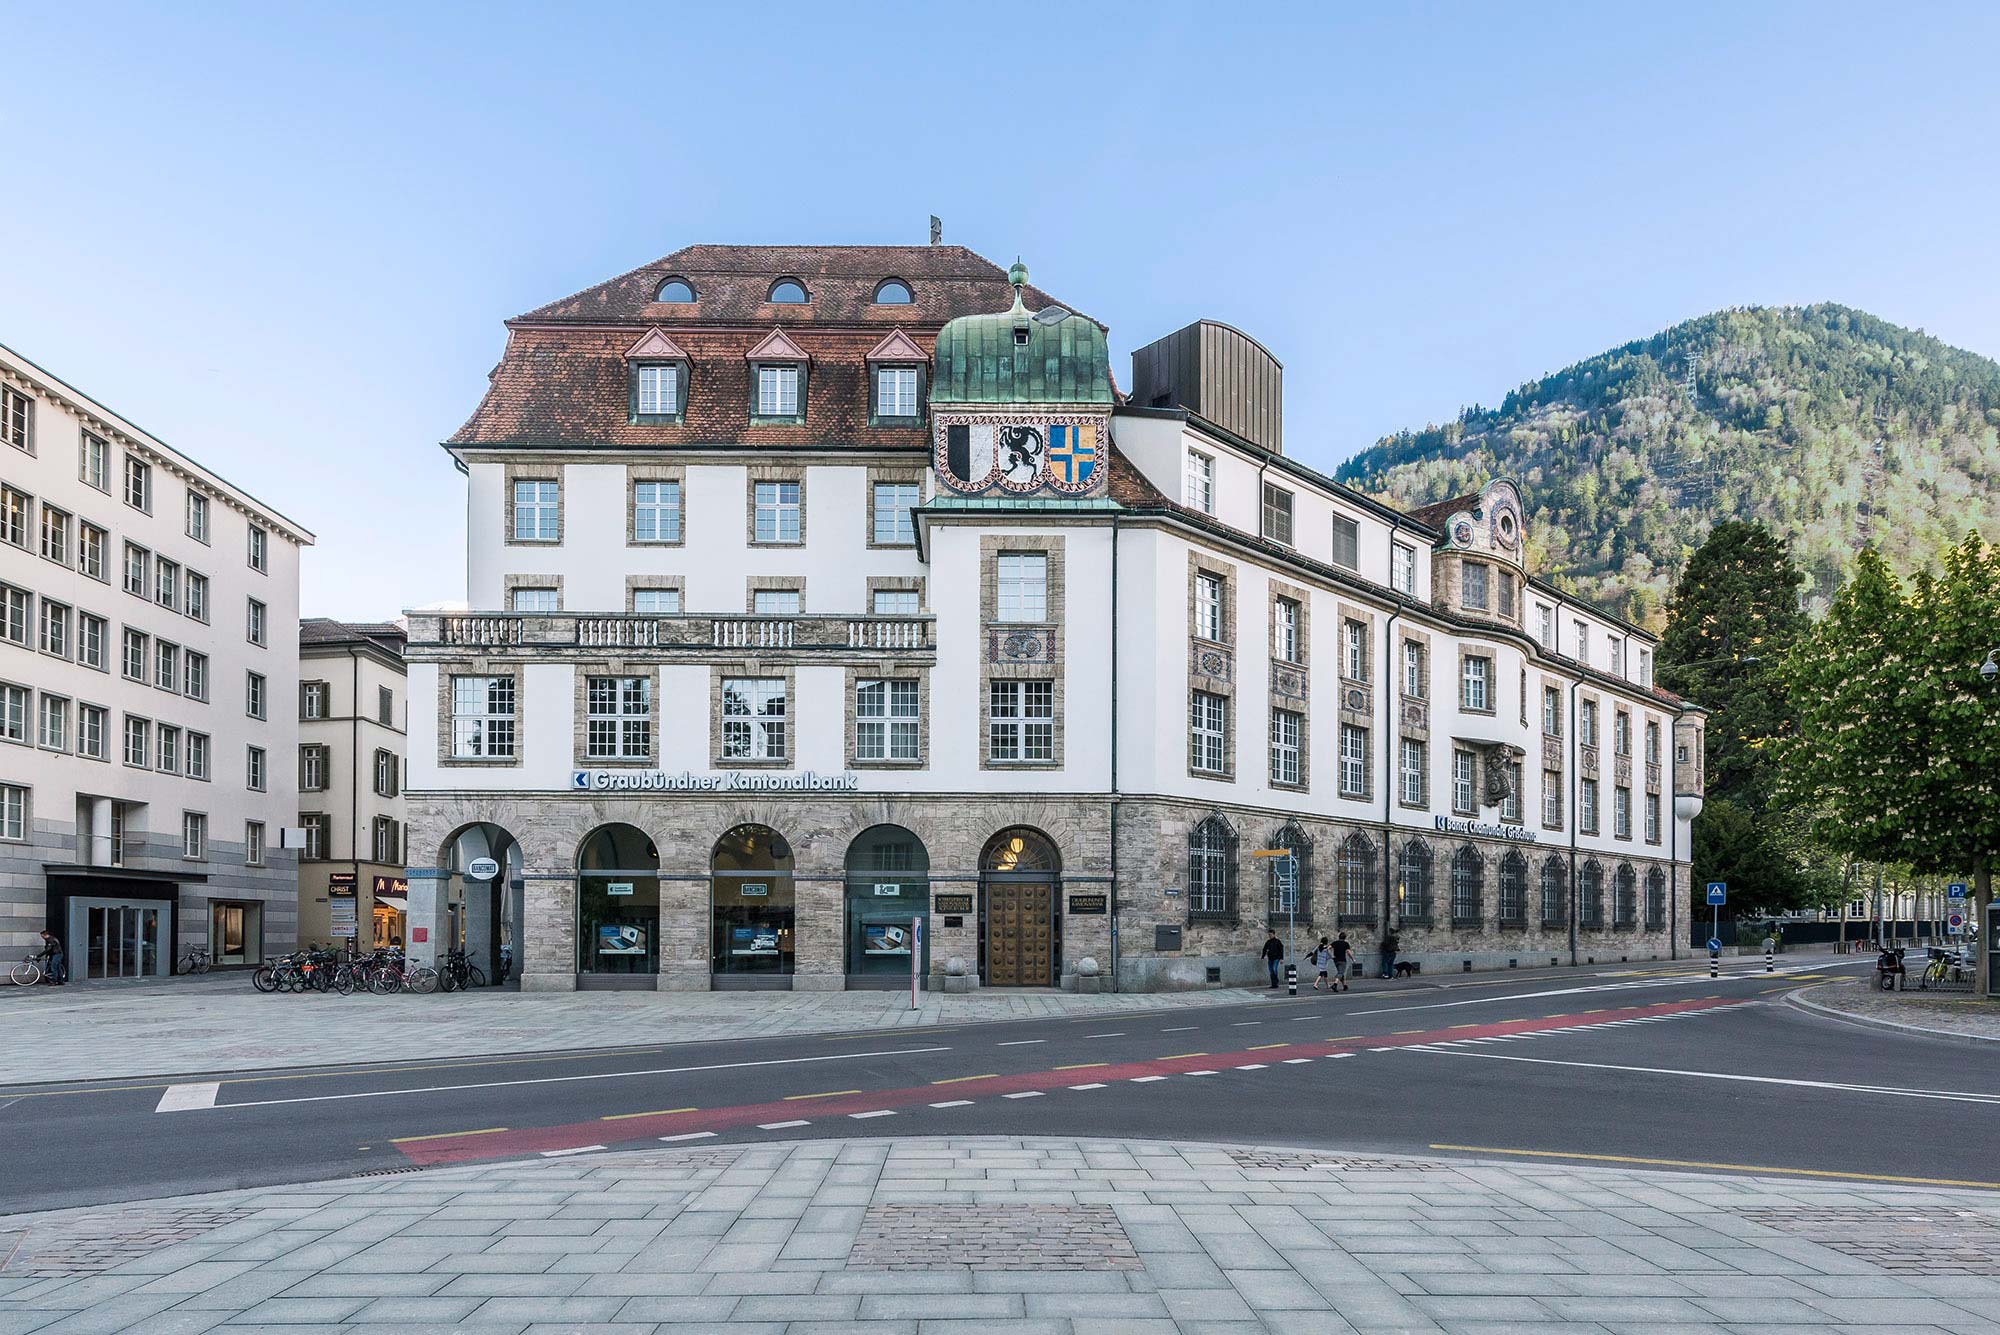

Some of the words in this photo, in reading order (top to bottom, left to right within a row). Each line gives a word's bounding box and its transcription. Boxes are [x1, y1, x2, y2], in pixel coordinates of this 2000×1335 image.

[594, 771, 721, 791] Graubündner
[727, 771, 858, 791] Kantonalbank
[1446, 817, 1469, 833] Banca
[1951, 886, 1960, 896] P
